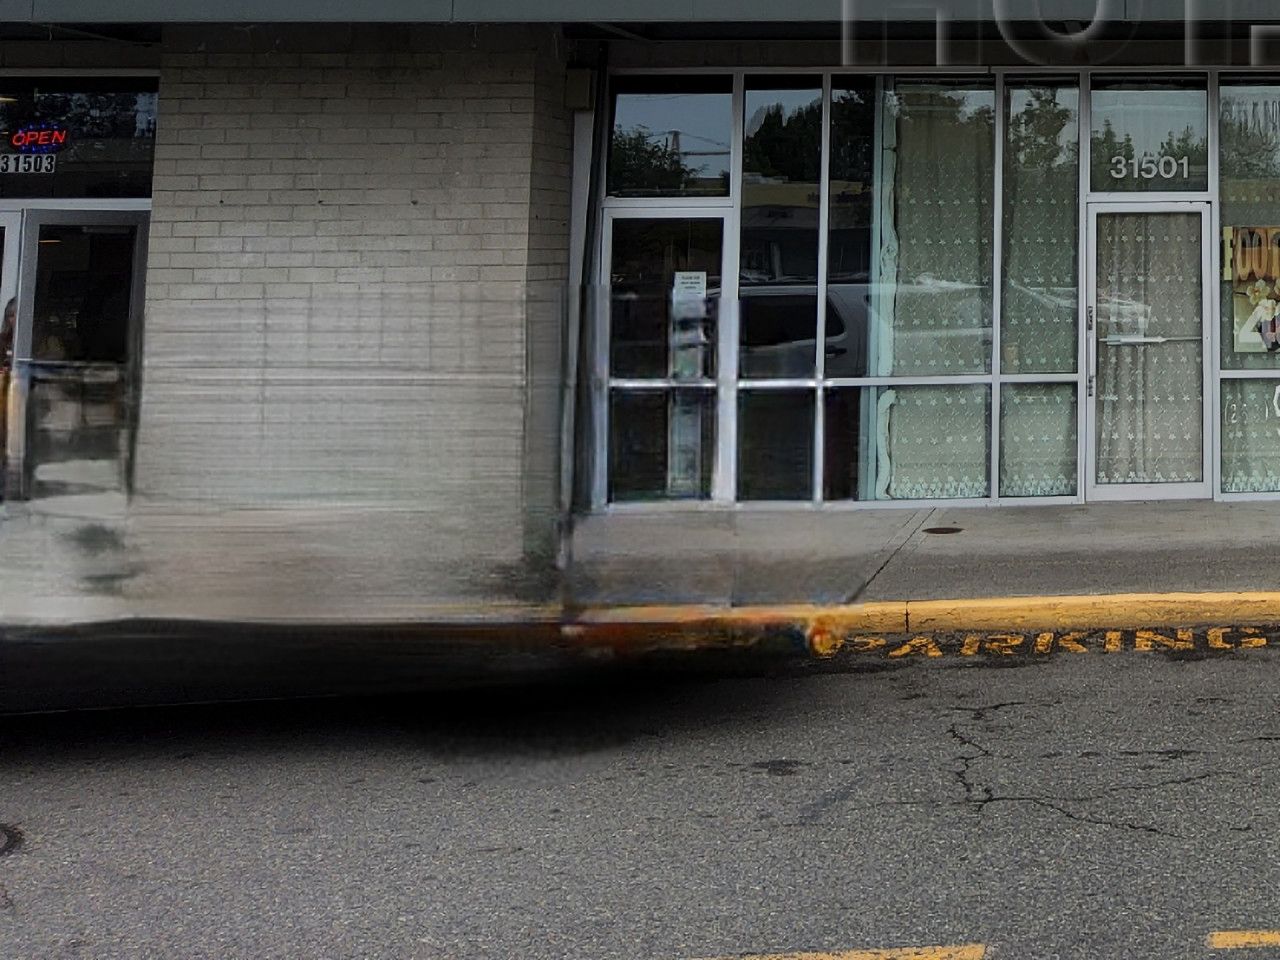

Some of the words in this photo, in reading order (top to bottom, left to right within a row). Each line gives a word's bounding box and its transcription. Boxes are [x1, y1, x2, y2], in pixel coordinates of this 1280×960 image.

[12, 130, 66, 145] OPEN
[0, 155, 54, 172] 31503
[1110, 155, 1188, 179] 31501
